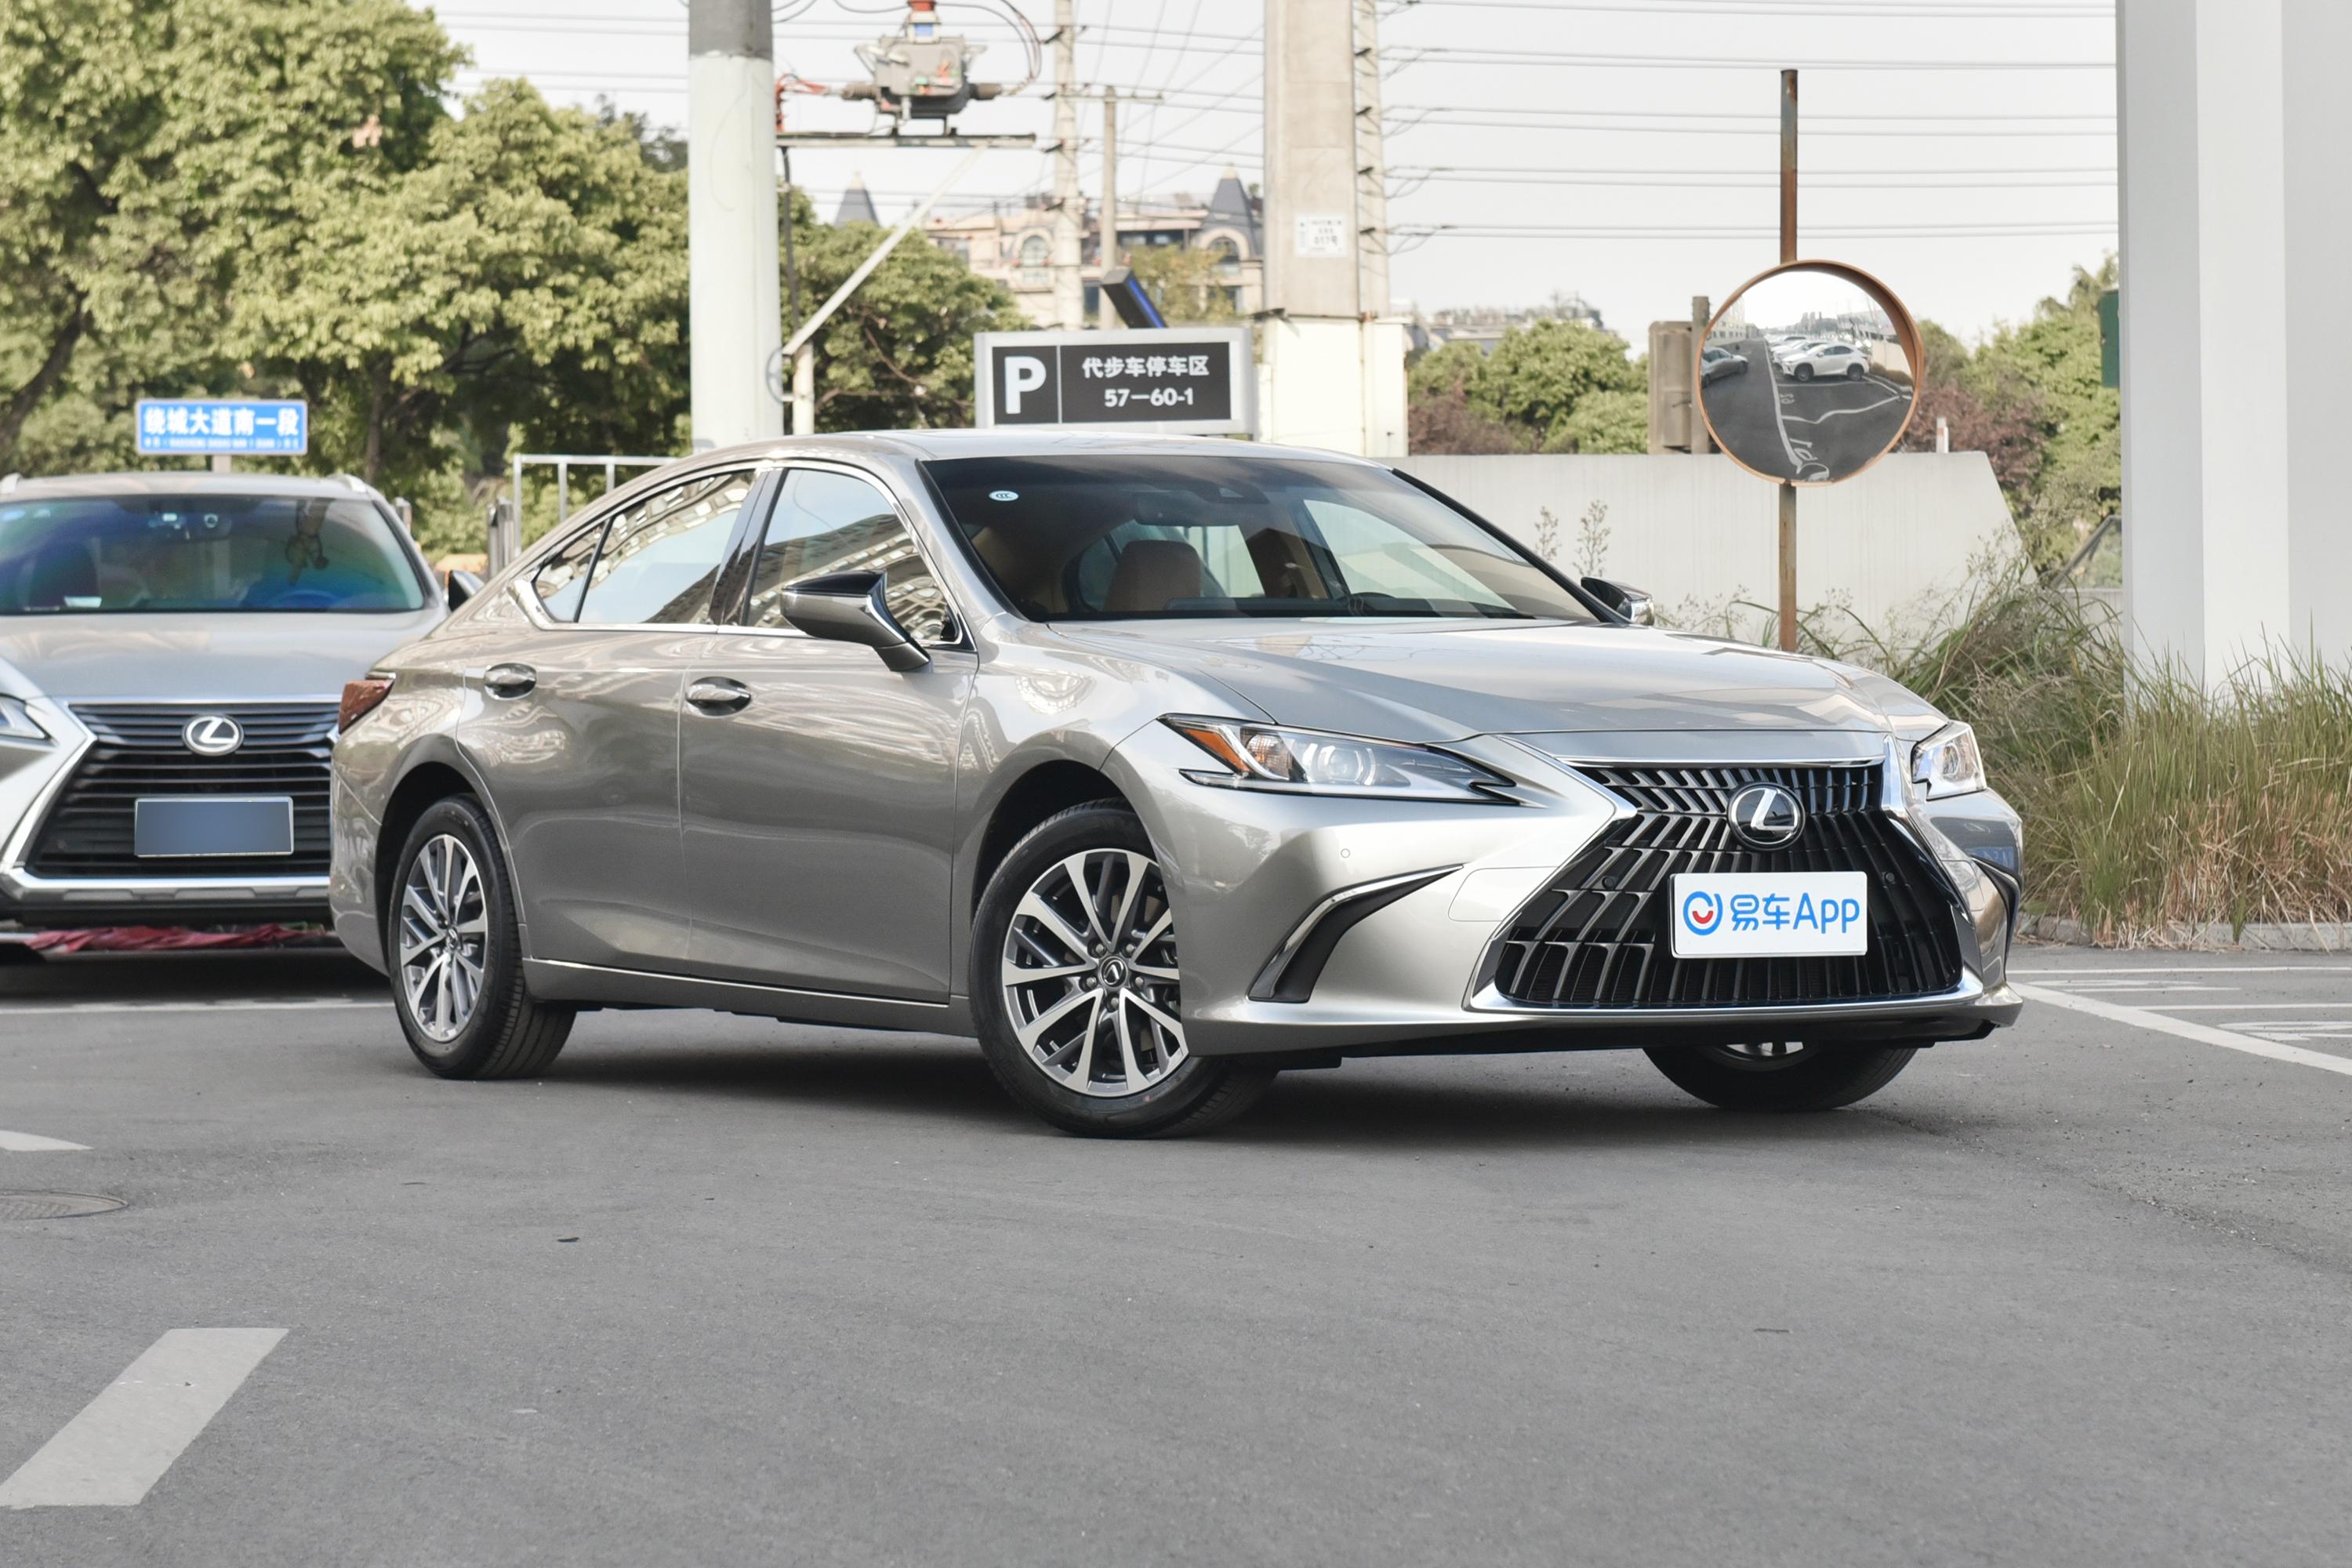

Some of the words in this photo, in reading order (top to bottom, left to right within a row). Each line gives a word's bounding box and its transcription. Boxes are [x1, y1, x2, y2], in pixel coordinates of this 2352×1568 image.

[1004, 356, 1047, 414] P
[1082, 355, 1210, 379] 代步车停车区
[1730, 892, 1860, 934] 易车App
